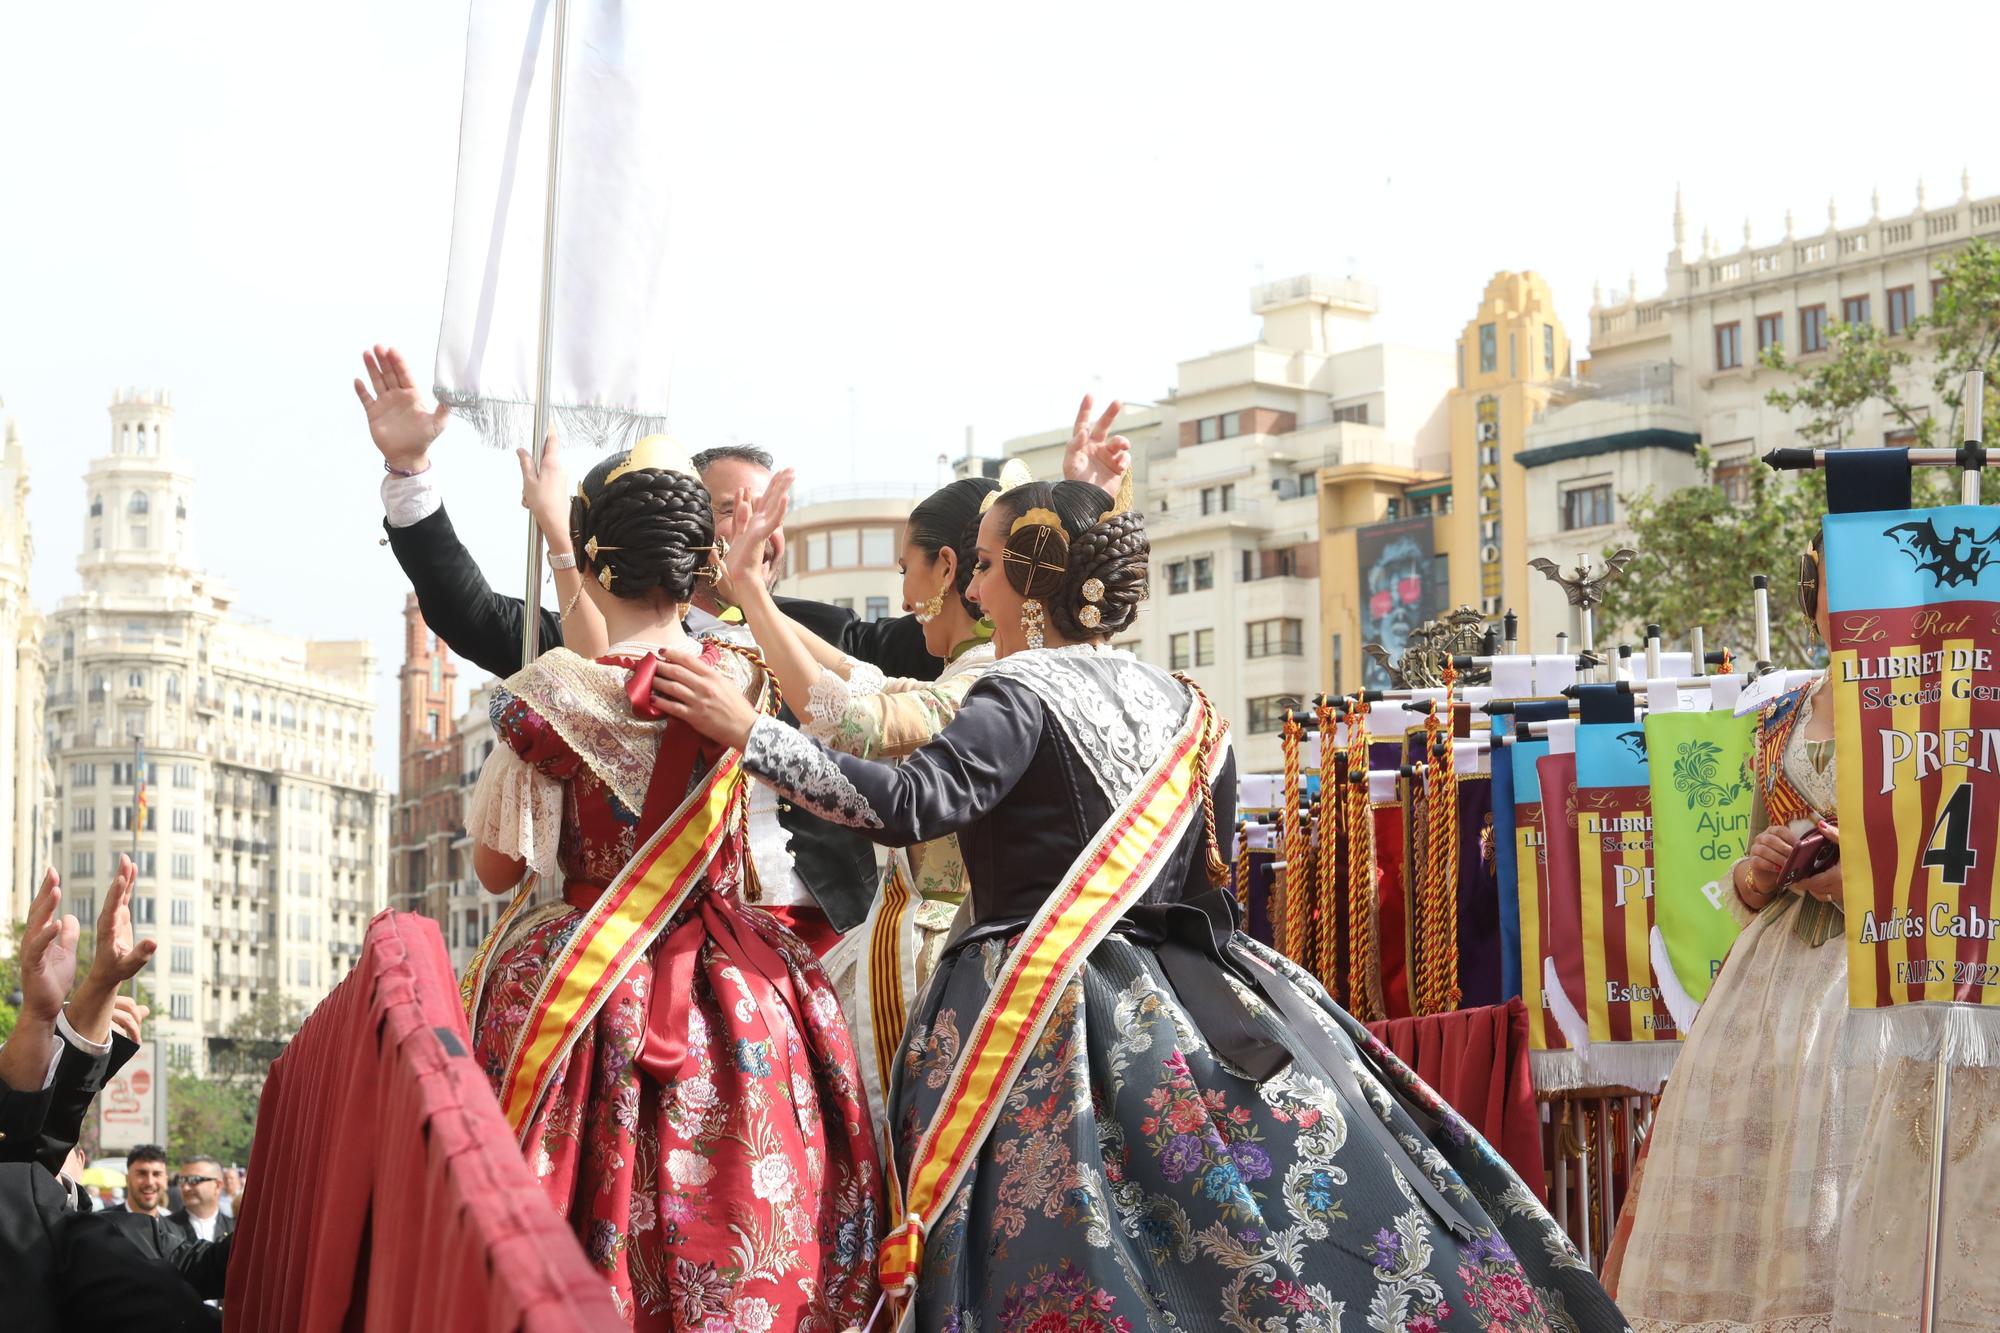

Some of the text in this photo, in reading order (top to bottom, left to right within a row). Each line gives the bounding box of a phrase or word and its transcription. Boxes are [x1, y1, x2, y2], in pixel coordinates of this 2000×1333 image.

[1478, 422, 1500, 563] RIALTO
[1840, 615, 1888, 643] Lo
[1911, 610, 1974, 638] Rat
[1843, 648, 1992, 682] LLIBRET DE
[1863, 681, 1941, 709] Secció
[1587, 791, 1620, 809] Lo
[1696, 811, 1750, 838] Ajun
[1922, 782, 1977, 885] 4
[1700, 839, 1732, 861] de
[1860, 902, 2000, 943] Andrés Cabr
[1952, 961, 2000, 986] 2022
